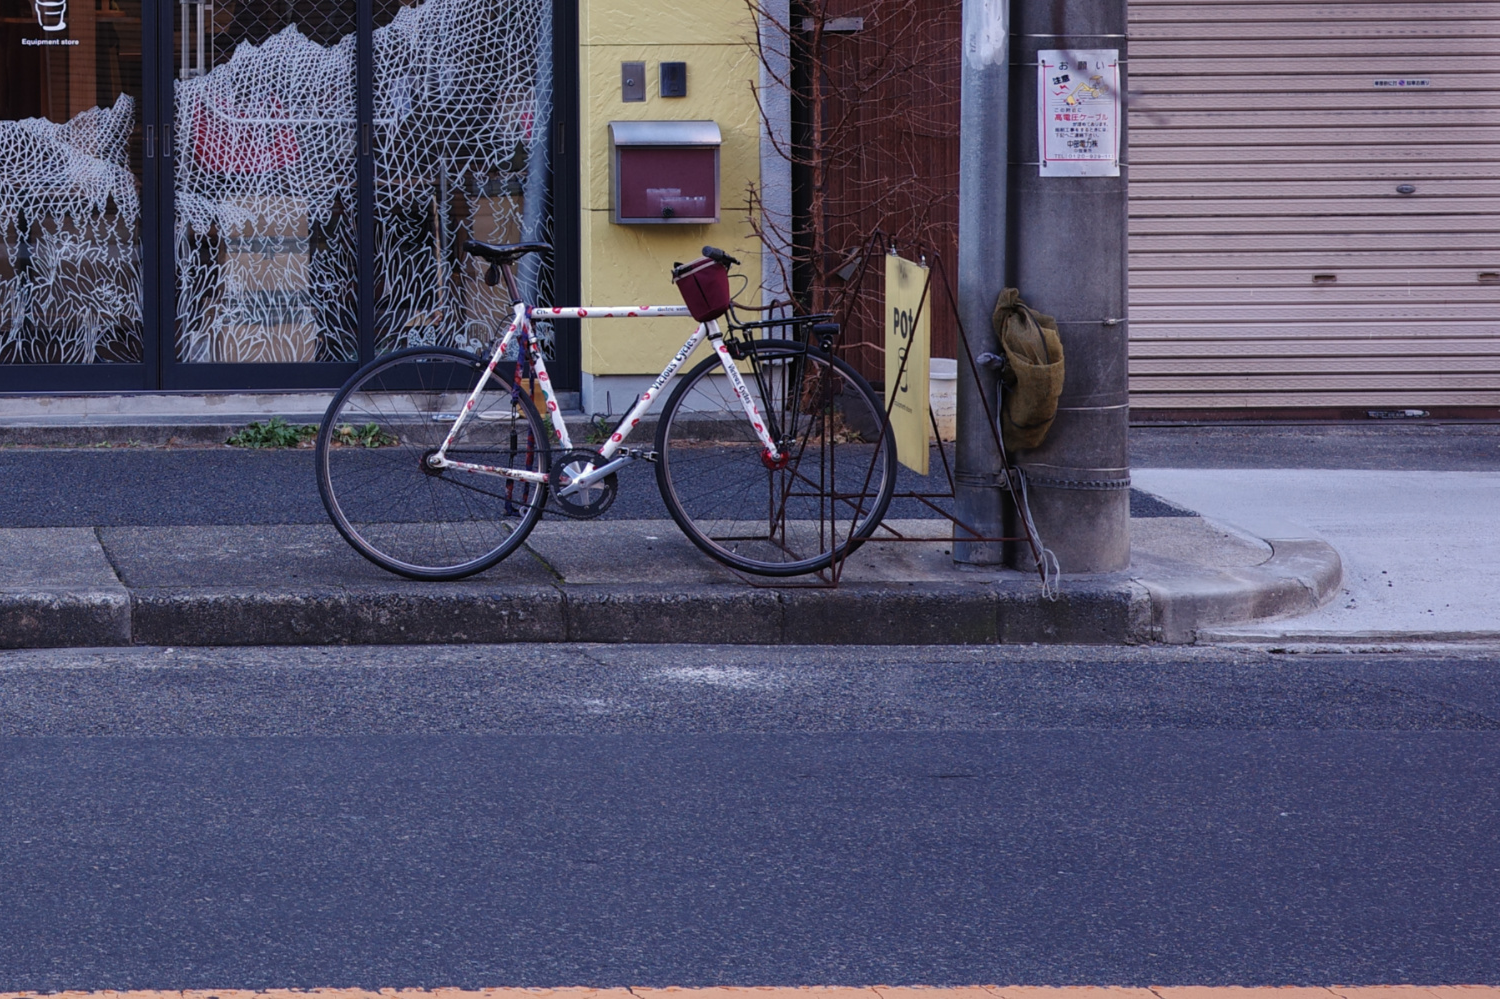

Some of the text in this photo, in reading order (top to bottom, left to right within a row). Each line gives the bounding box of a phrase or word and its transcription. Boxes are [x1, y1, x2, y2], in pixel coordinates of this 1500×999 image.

[21, 38, 80, 47] Equipment store
[1052, 74, 1070, 85] 注意
[1054, 113, 1109, 122] 高電圧ケーブル
[651, 336, 698, 390] Vicious Cycles
[728, 363, 752, 405] Vicious Cycles
